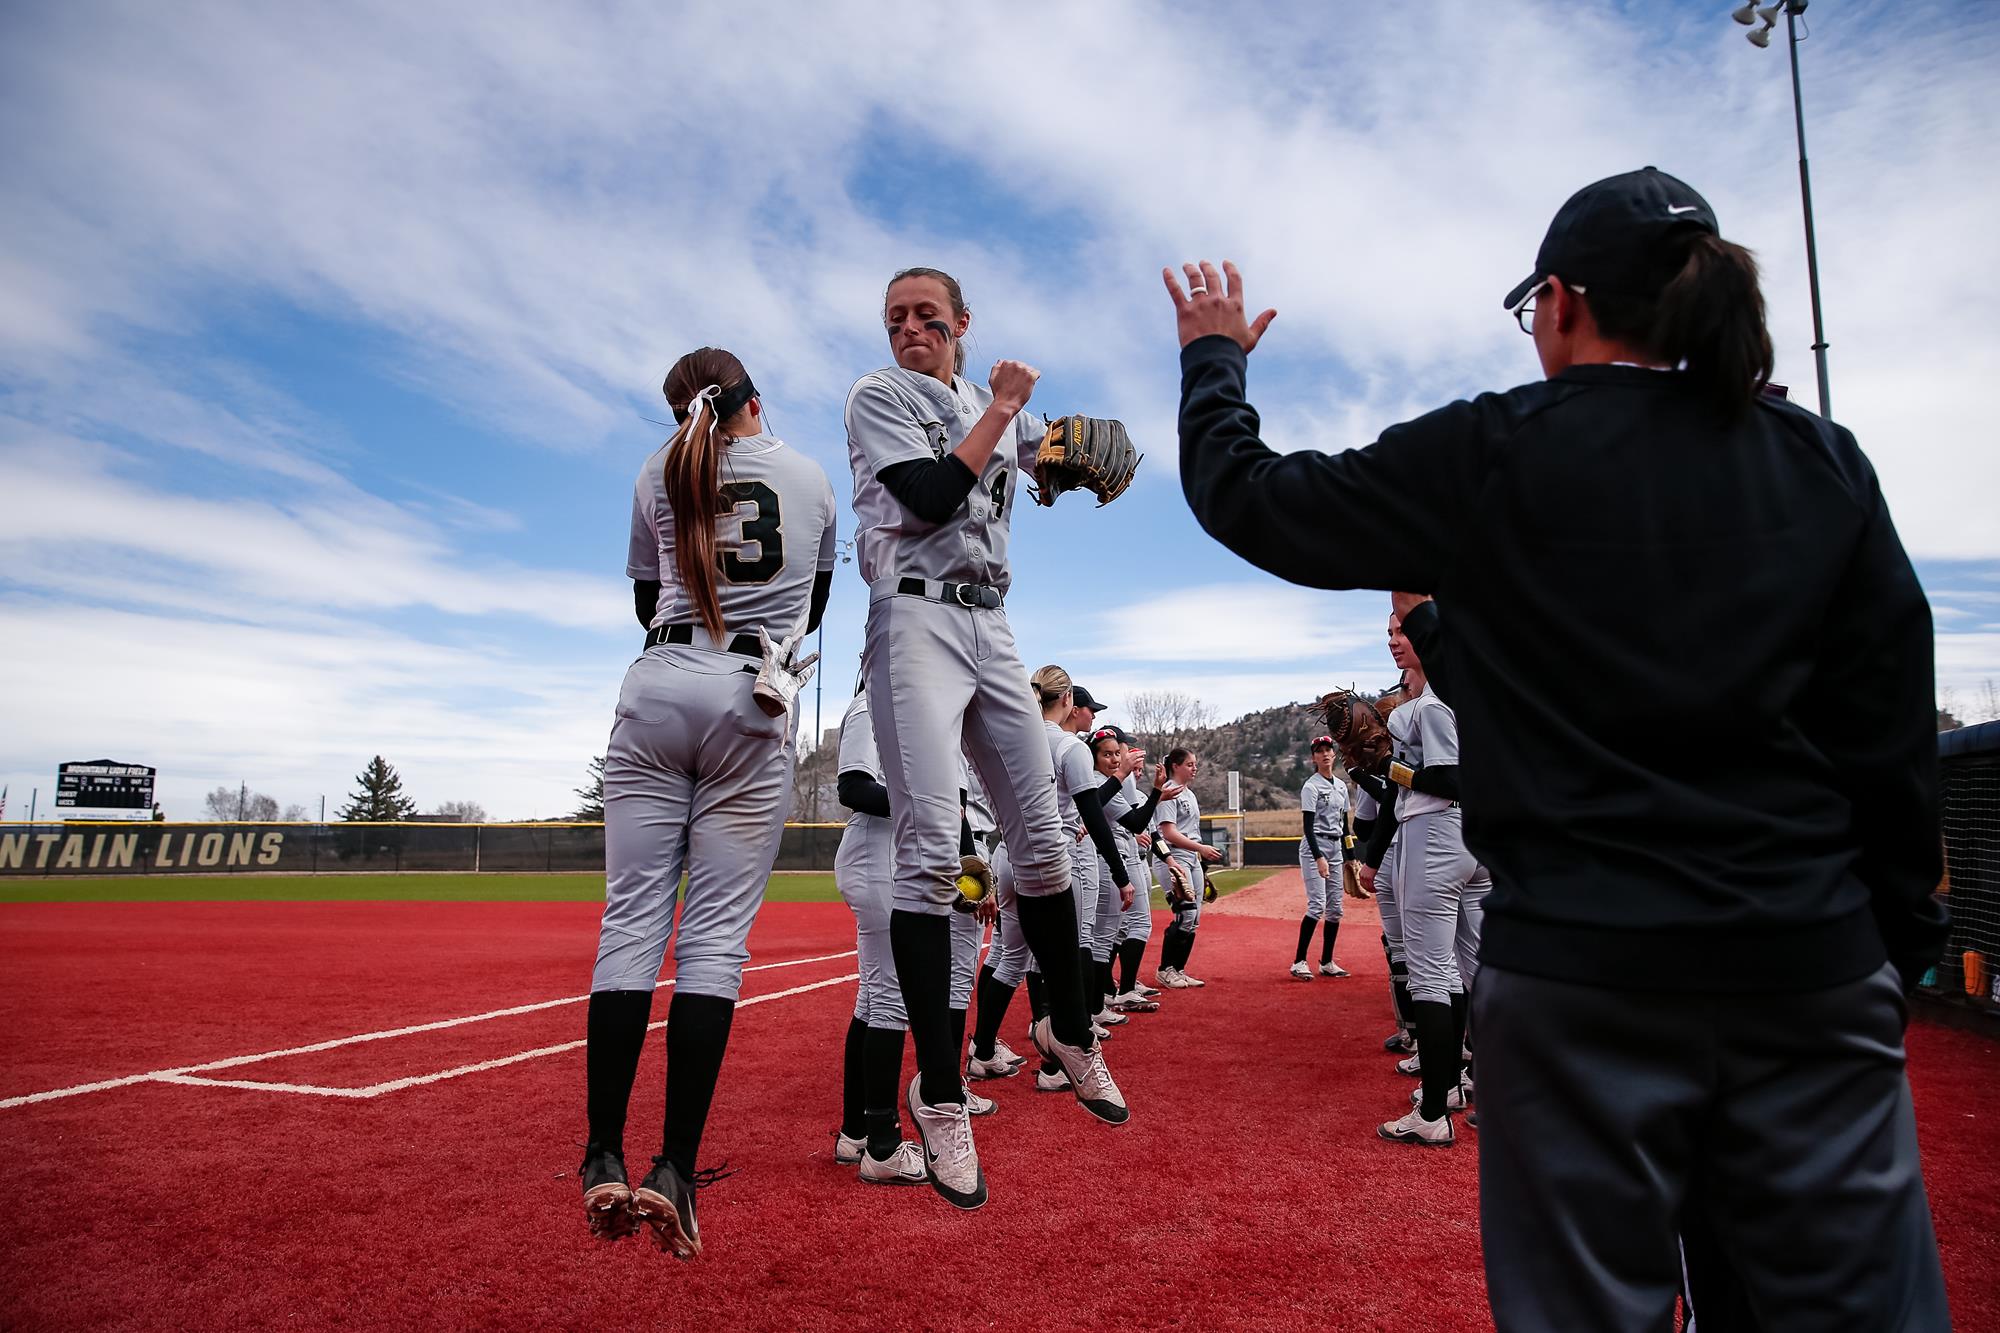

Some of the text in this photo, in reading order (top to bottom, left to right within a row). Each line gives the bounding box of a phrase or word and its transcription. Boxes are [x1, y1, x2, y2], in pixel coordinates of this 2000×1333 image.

[988, 468, 1008, 519] 4
[714, 480, 785, 586] 3
[0, 832, 284, 868] NTAIN LIONS
